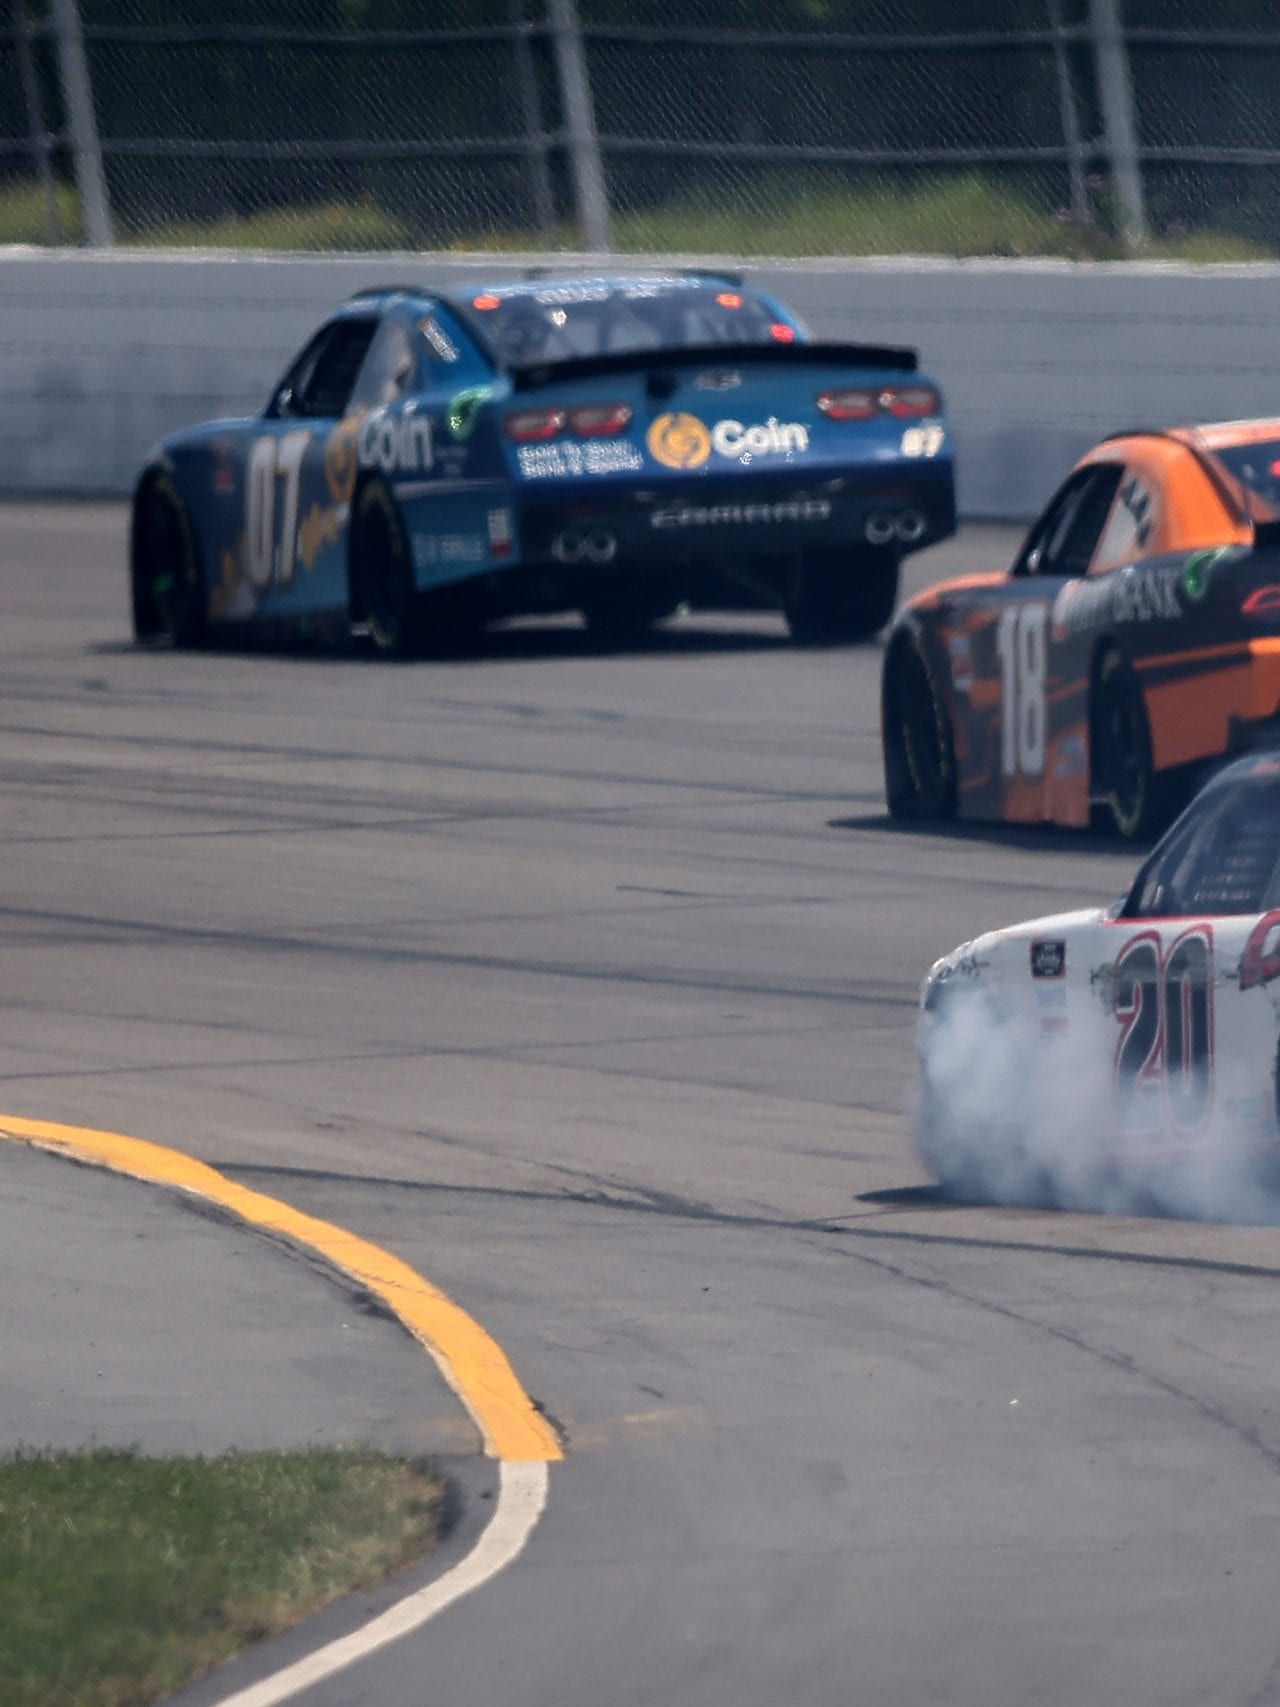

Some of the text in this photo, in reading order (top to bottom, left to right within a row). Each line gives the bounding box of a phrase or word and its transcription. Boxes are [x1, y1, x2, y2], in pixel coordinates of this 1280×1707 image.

[245, 428, 312, 587] 07
[713, 416, 810, 458] Coin
[998, 603, 1049, 775] 18
[1113, 922, 1215, 1136] 20
